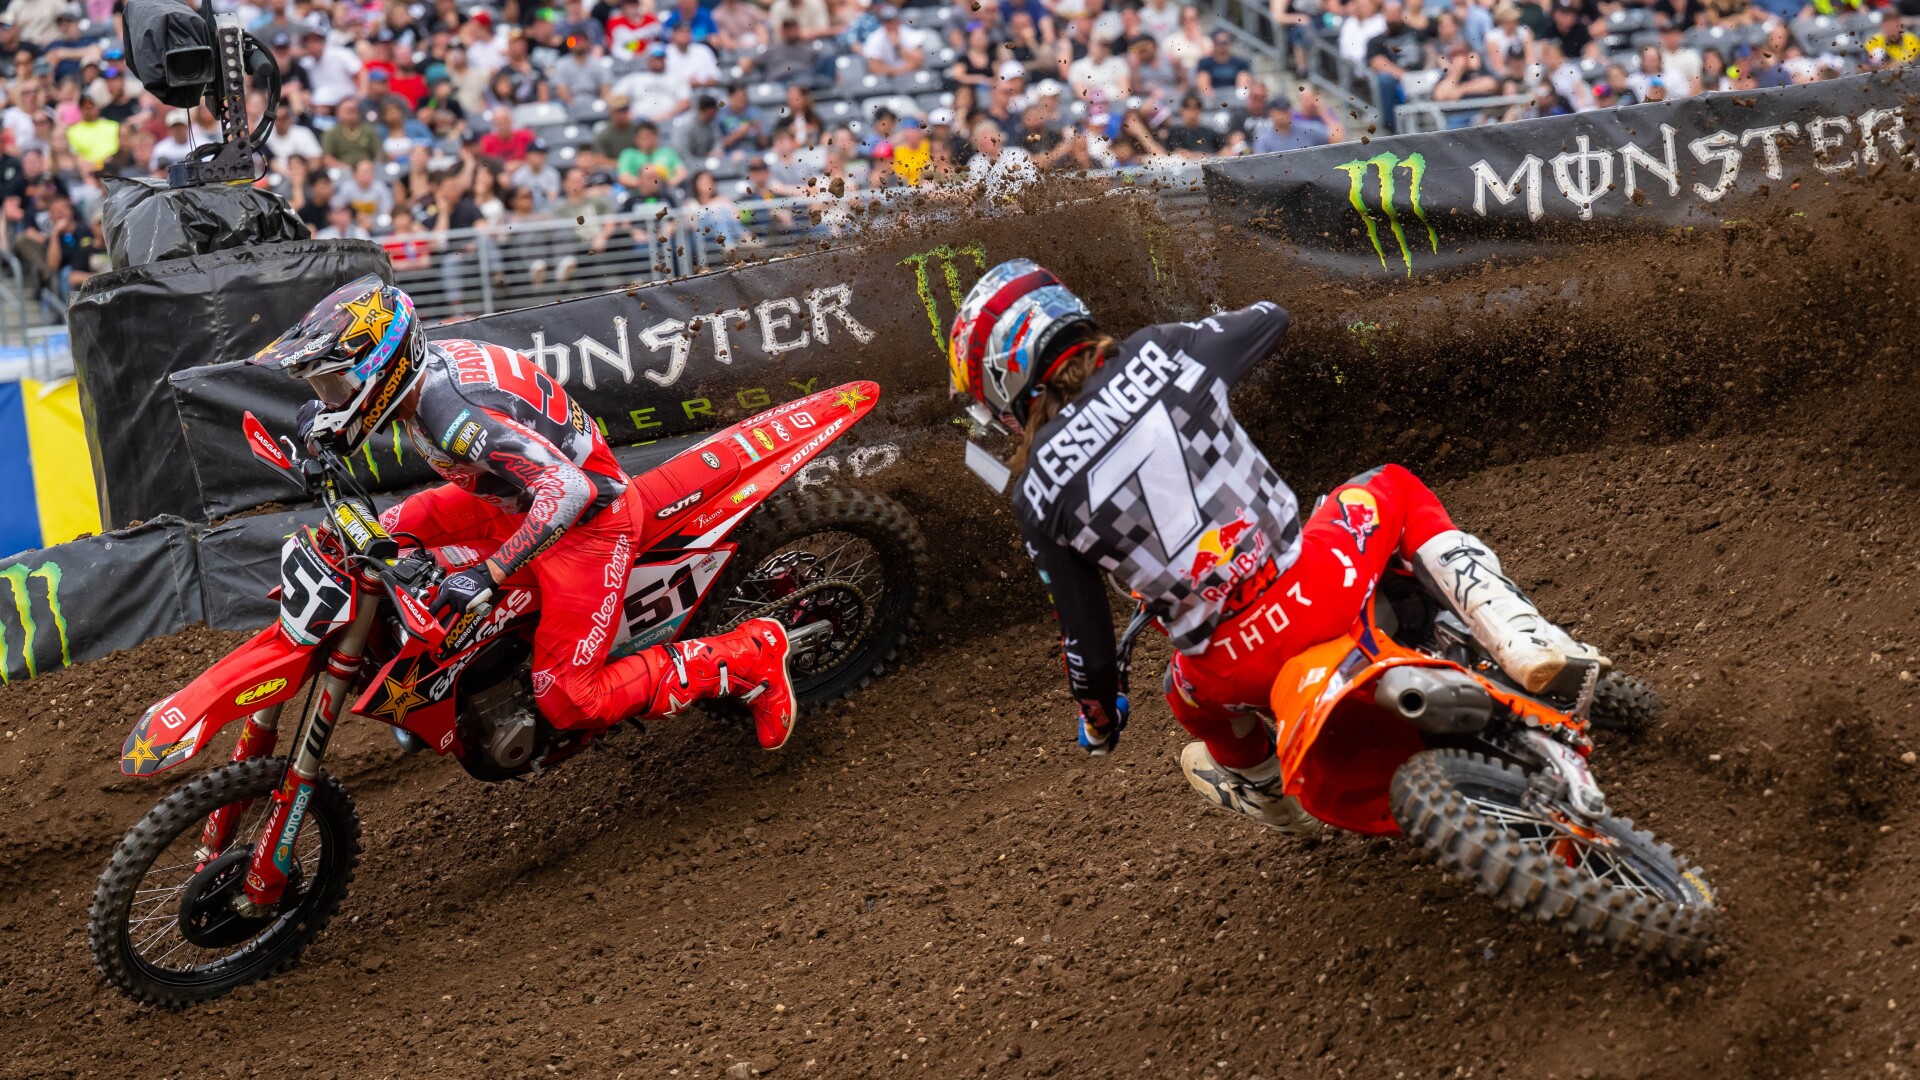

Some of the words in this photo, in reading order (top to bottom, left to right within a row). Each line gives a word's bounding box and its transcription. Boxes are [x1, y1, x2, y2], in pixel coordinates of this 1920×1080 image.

[519, 283, 876, 391] ONSTER
[363, 356, 409, 428] ROCKSTAR
[595, 377, 818, 436] ERGY
[253, 431, 282, 459] GASGAS
[444, 411, 470, 442] MOTOREX
[469, 430, 488, 461] WP
[791, 418, 843, 464] DUNLOP
[1023, 340, 1179, 522] PLESSINGER
[658, 491, 702, 518] GUTS
[1086, 398, 1202, 560] 7
[281, 546, 350, 639] 51
[1202, 565, 1241, 602] Red
[1234, 528, 1265, 575] Bull
[401, 594, 426, 626] GASGAS
[445, 611, 478, 648] ROCKS
[572, 626, 607, 666] Troy
[591, 591, 617, 628] Lee
[623, 563, 699, 638] 51
[1214, 581, 1312, 660] THOR
[454, 625, 474, 648] ENERGY
[234, 677, 288, 706] FMF
[306, 687, 335, 760] WP
[281, 790, 311, 845] MOTOREX
